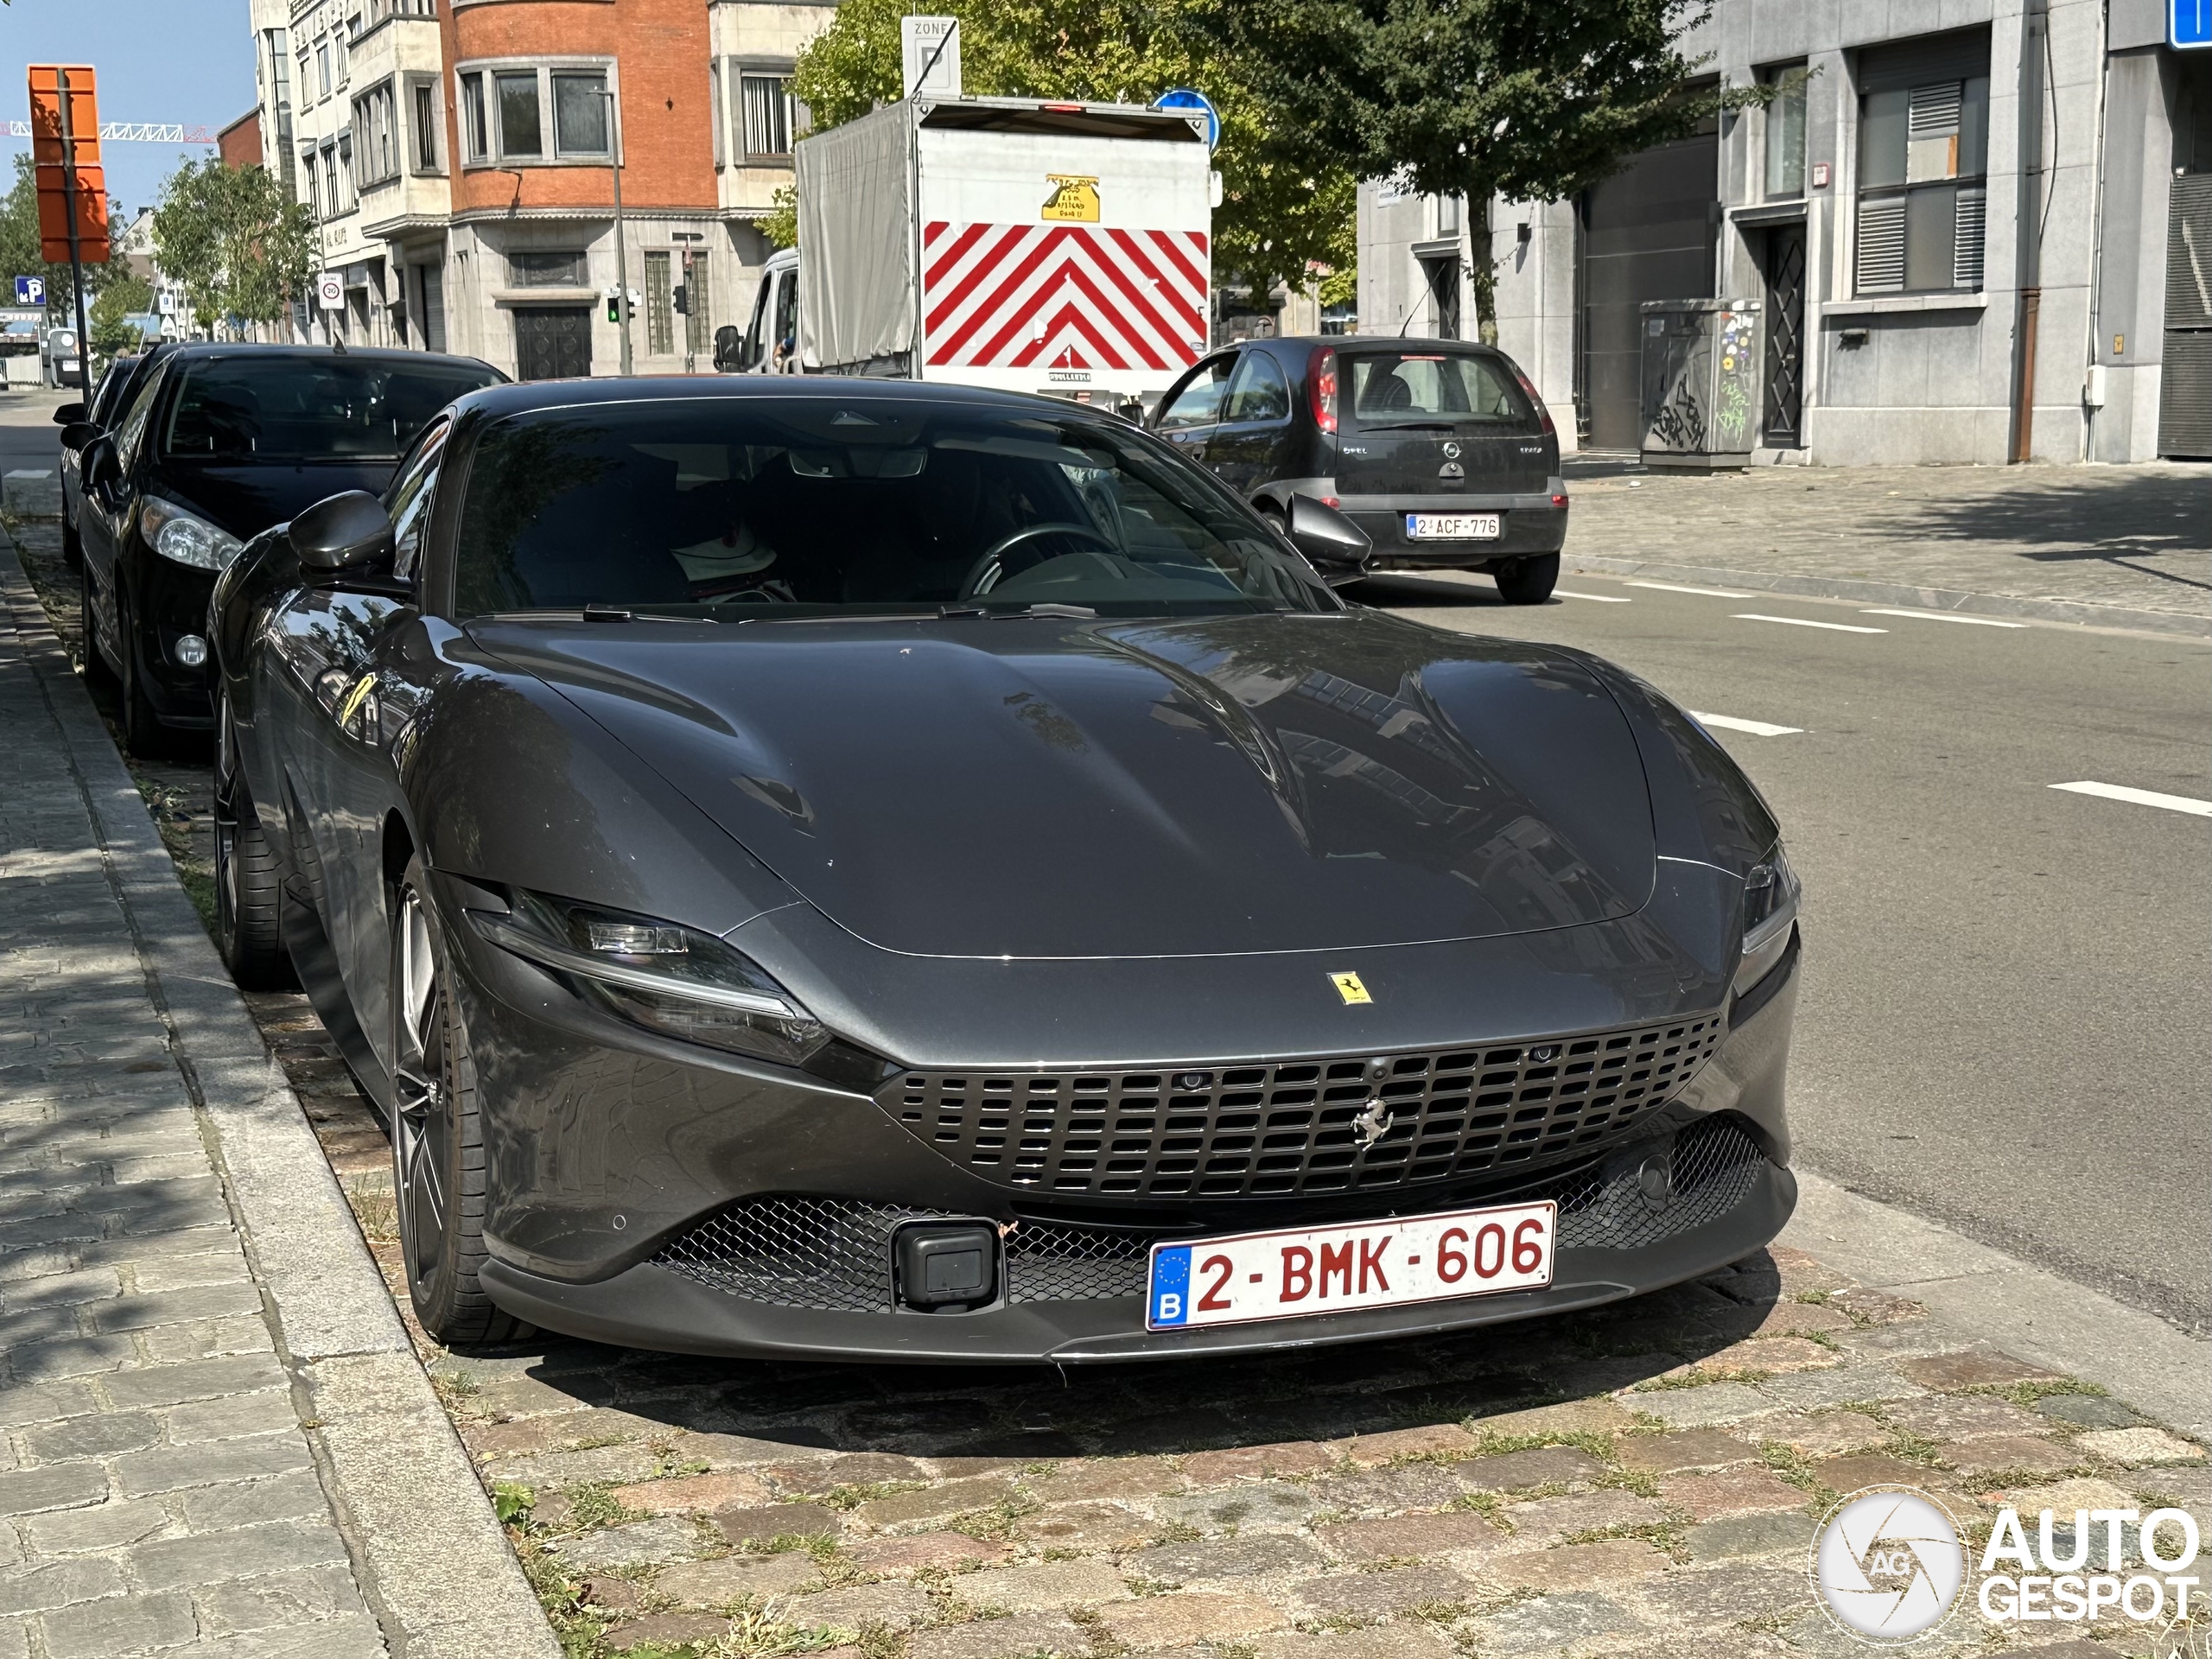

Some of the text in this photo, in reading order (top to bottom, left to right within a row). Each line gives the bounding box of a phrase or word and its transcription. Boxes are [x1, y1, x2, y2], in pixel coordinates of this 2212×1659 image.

[915, 22, 948, 35] ZONE
[1160, 1218, 1544, 1319] B 2-BMK-606
